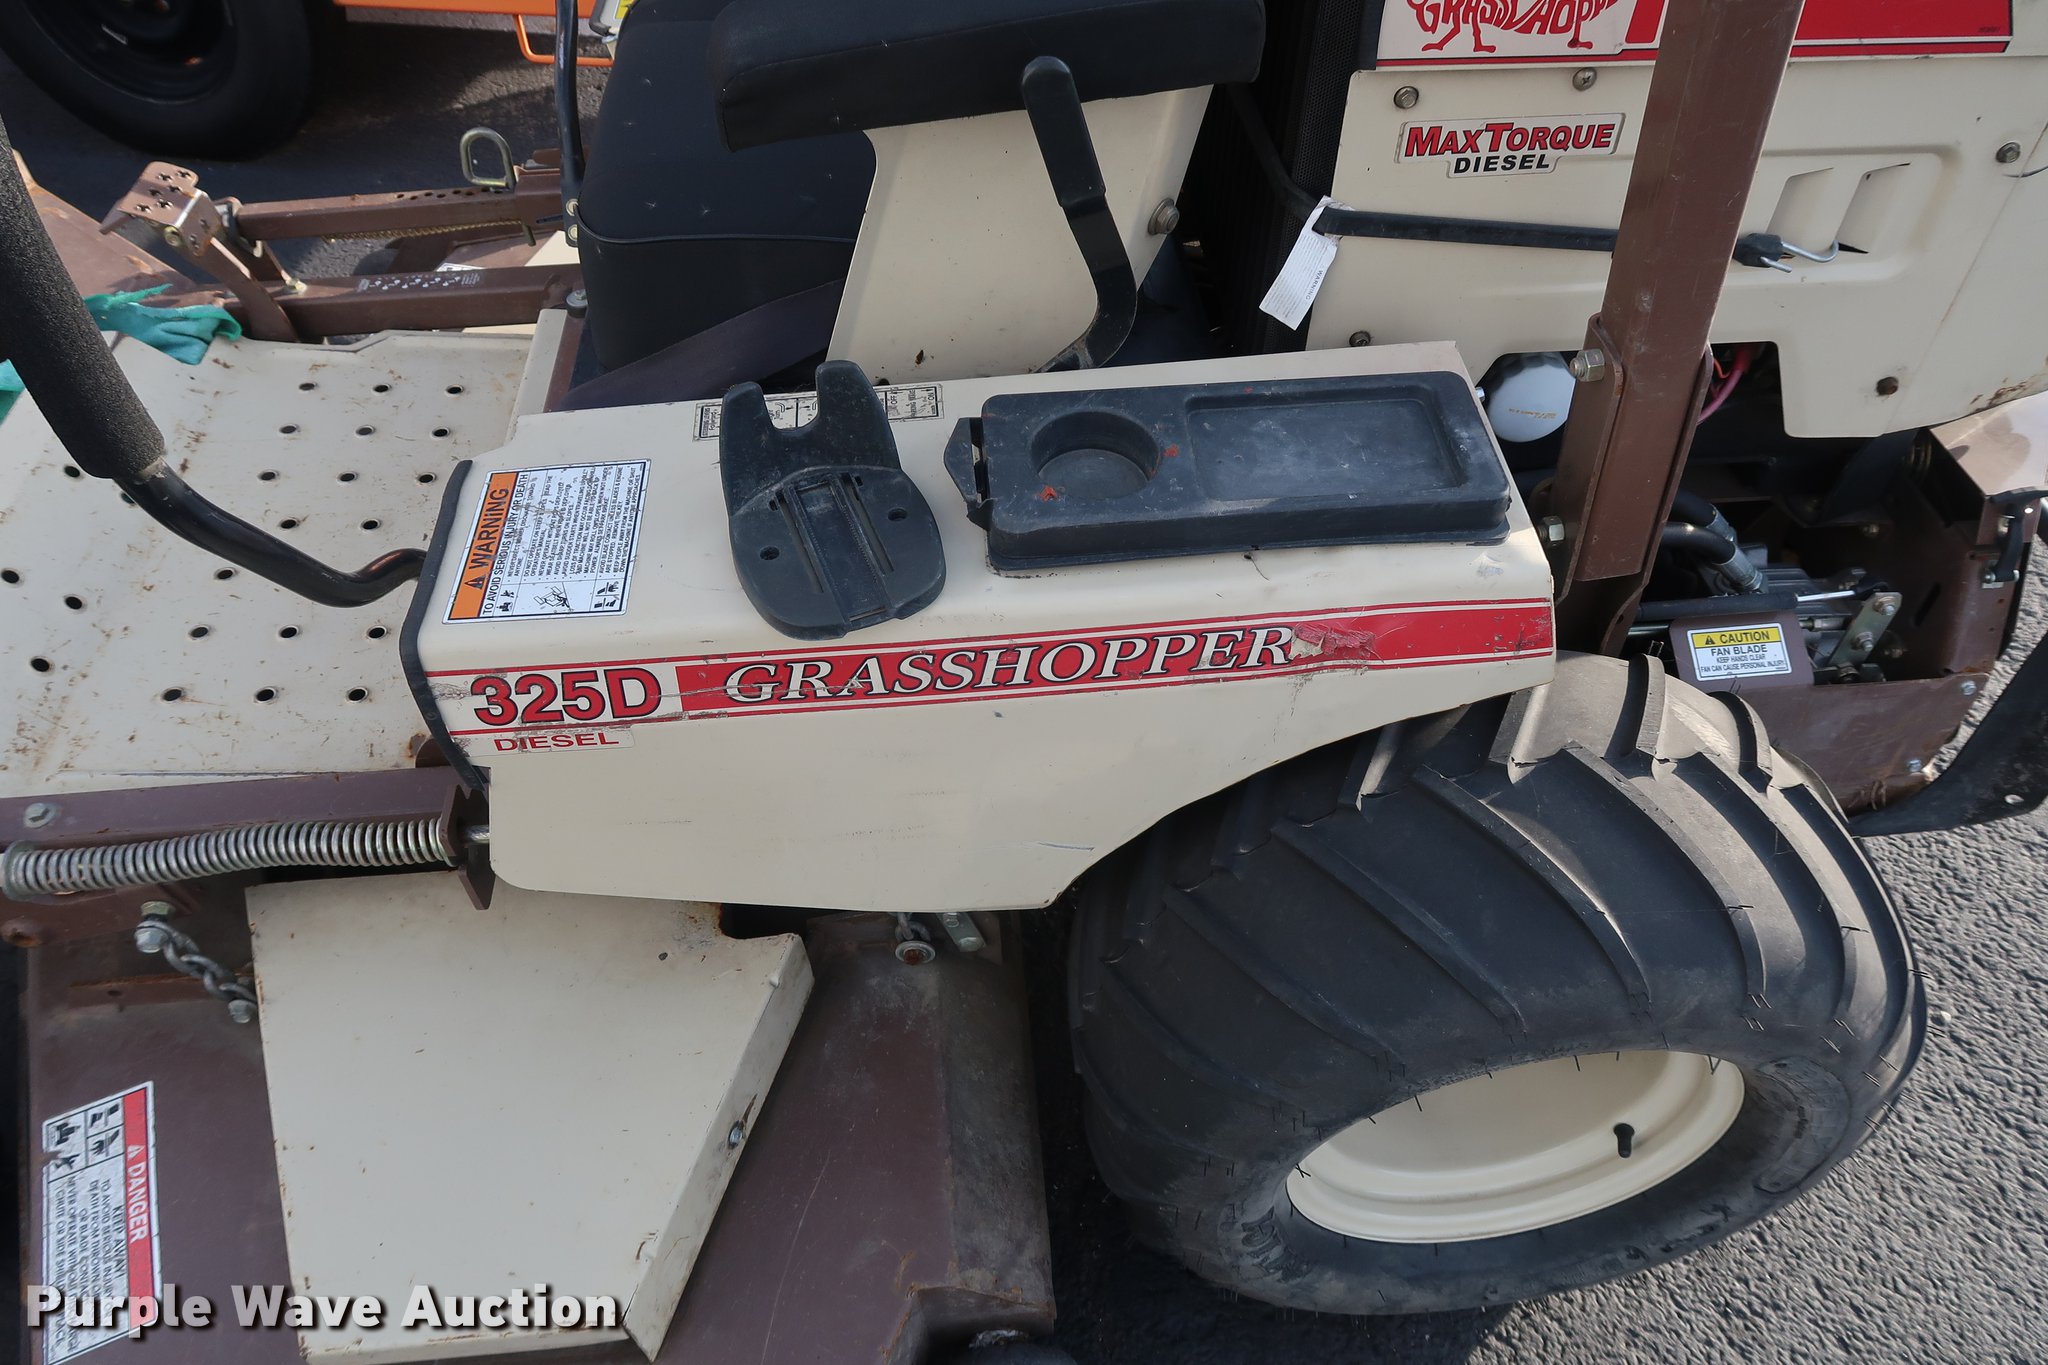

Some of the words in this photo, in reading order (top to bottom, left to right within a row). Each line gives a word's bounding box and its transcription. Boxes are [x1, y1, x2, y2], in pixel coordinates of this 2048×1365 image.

[1453, 154, 1550, 174] DIESEL
[1306, 270, 1324, 300] WARNING
[928, 392, 934, 401] ON
[513, 474, 528, 497] DEATH
[510, 500, 521, 510] OR
[468, 488, 510, 569] WARNING
[502, 512, 518, 538] INJURY
[493, 540, 510, 574] SERIOUS
[553, 560, 561, 574] AVOID
[486, 577, 501, 601] AVOID
[482, 603, 494, 614] TO
[1711, 648, 1730, 656] FAN
[1734, 644, 1768, 654] BLADE
[1720, 631, 1770, 644] CAUTION
[470, 667, 662, 726] 325D
[724, 626, 1294, 703] GRASSHOPPER
[494, 732, 620, 752] DIESEL
[66, 1175, 76, 1205] NEVER
[89, 1179, 98, 1209] DEATH
[100, 1178, 110, 1192] TO
[54, 1189, 64, 1218] CHUTE
[78, 1208, 86, 1223] OR
[101, 1193, 111, 1224] AVOID
[127, 1161, 148, 1243] DANGER
[54, 1220, 64, 1236] OR
[66, 1205, 77, 1247] OPERATE
[90, 1210, 99, 1239] FROM
[112, 1204, 124, 1235] KEEP
[54, 1236, 64, 1256] SIDE
[78, 1224, 87, 1254] BLADE
[101, 1224, 112, 1264] SERIOUS
[90, 1240, 100, 1282] THROWN
